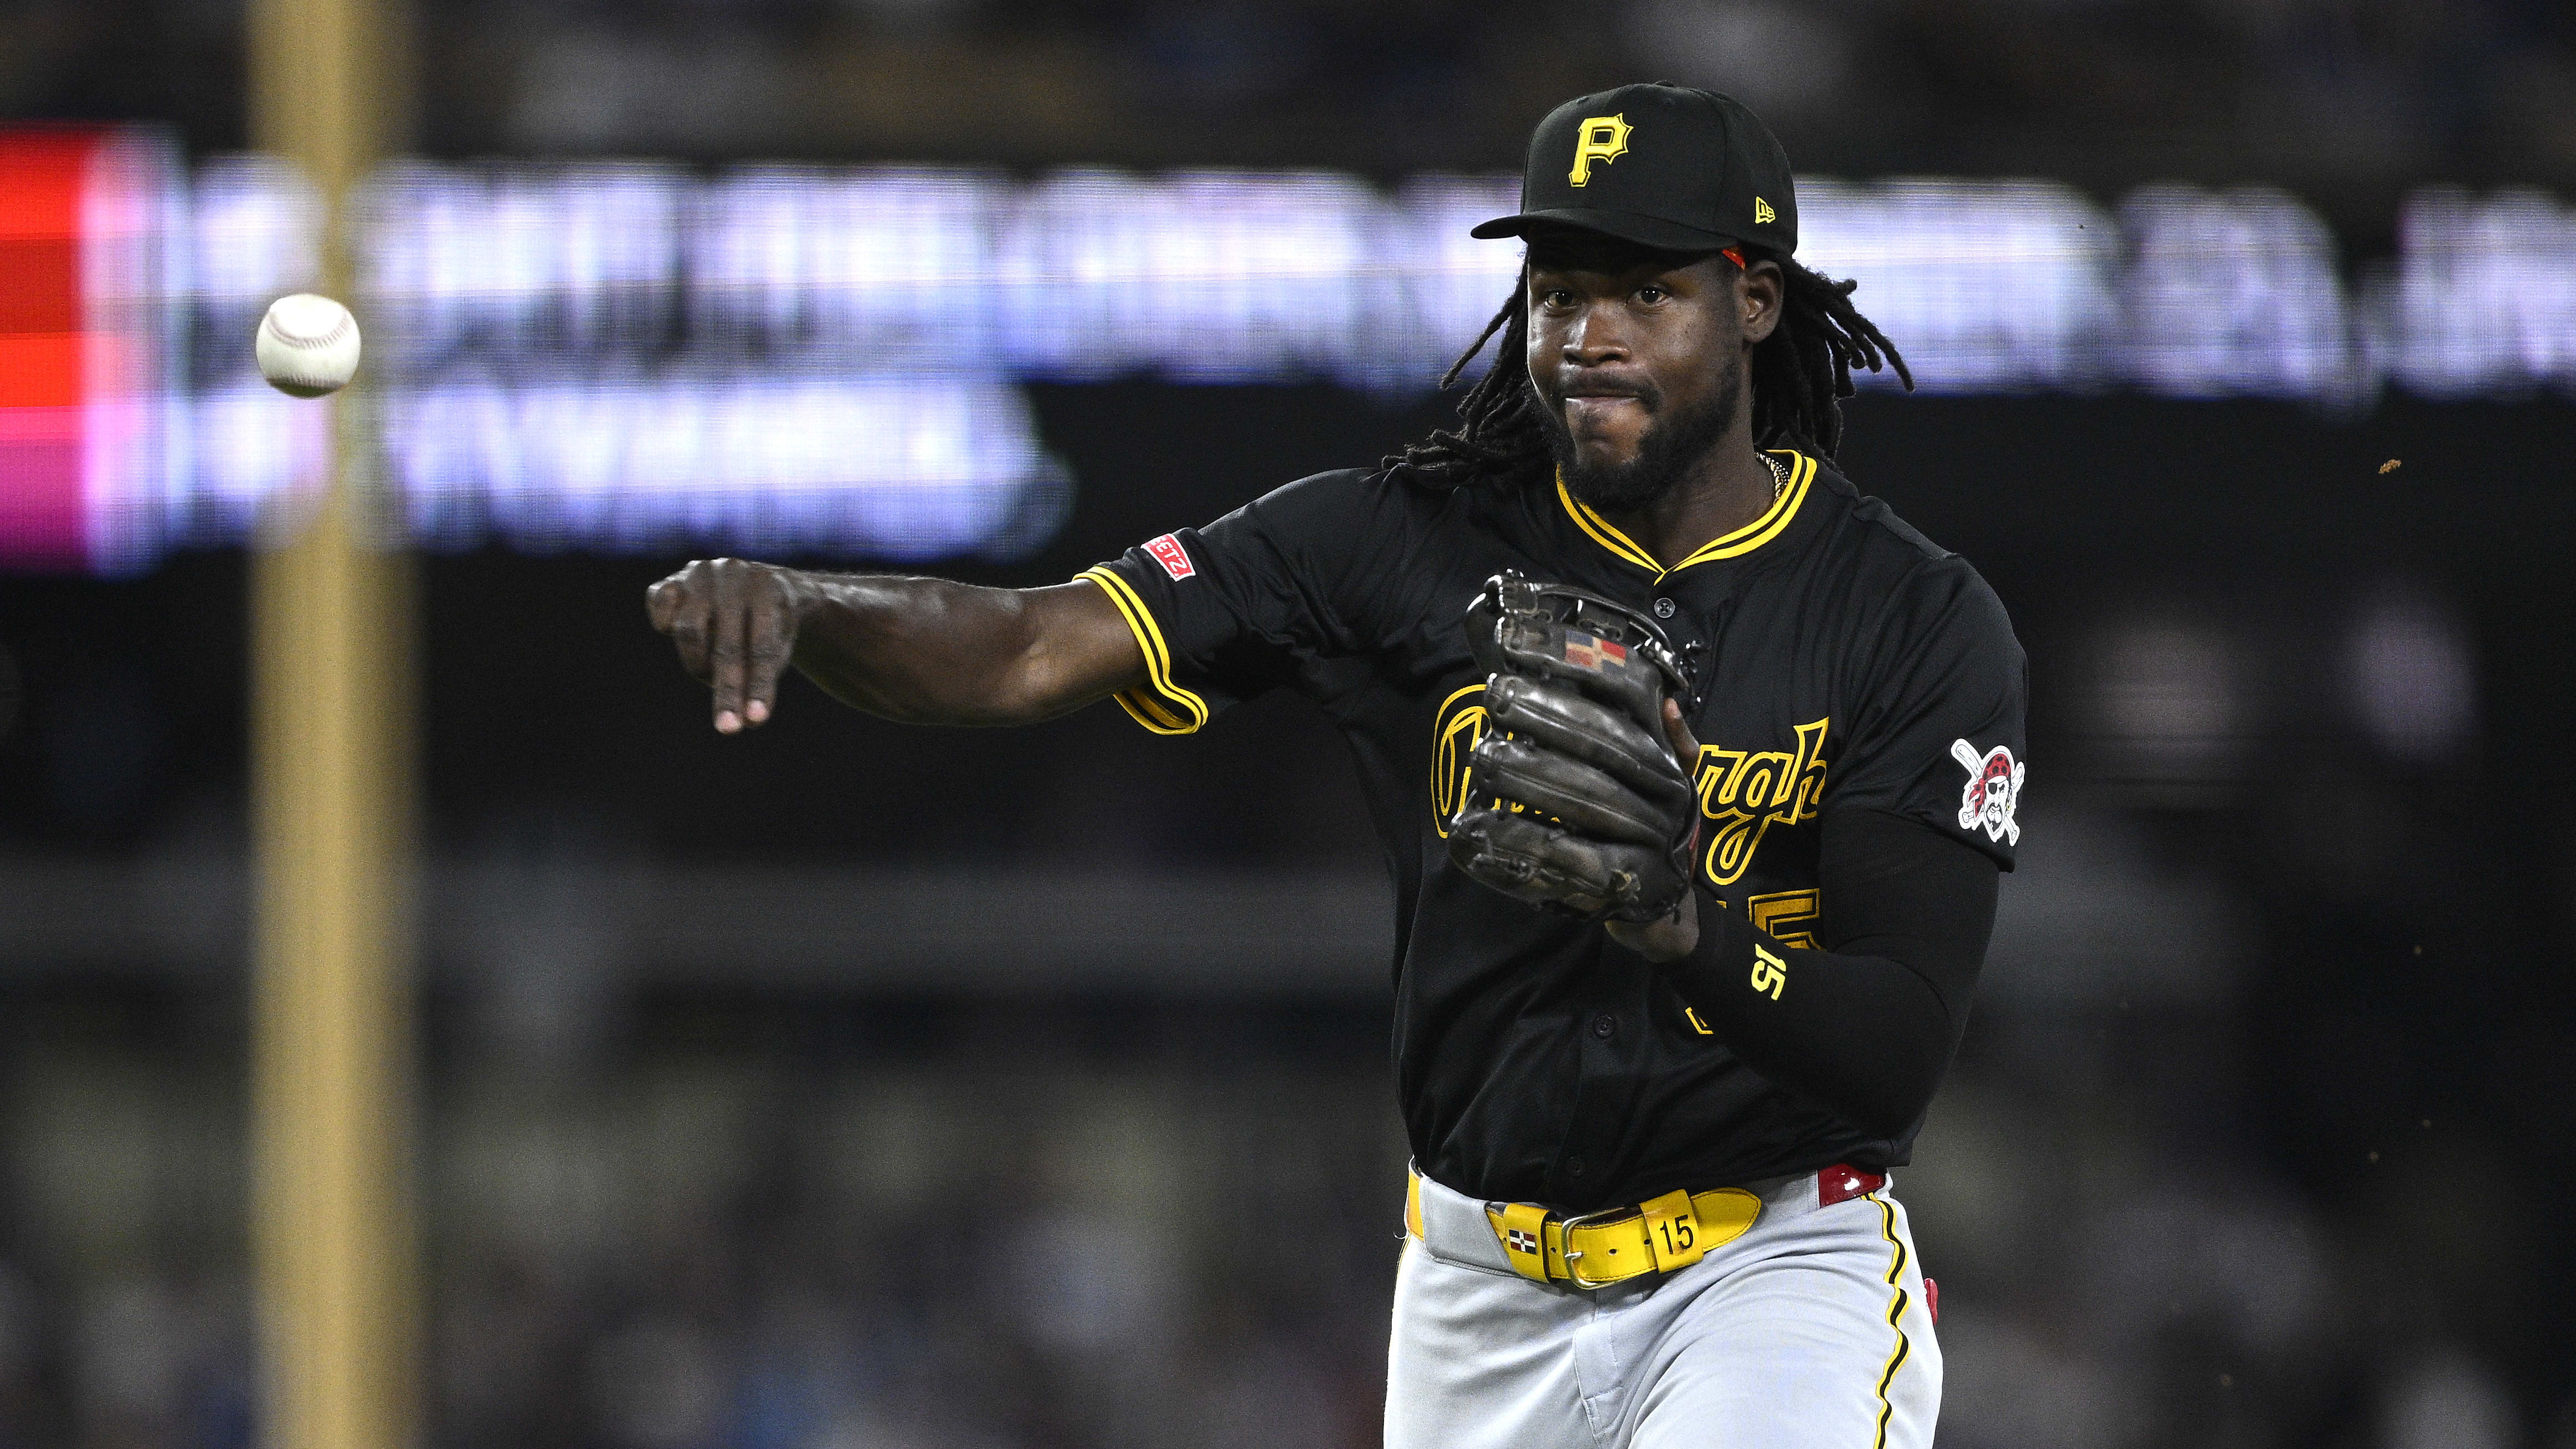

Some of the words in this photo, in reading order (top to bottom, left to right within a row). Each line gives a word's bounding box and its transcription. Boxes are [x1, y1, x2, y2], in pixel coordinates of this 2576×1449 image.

[1568, 113, 1633, 187] P
[1751, 943, 1786, 1001] 15
[1660, 1214, 1693, 1255] 15
